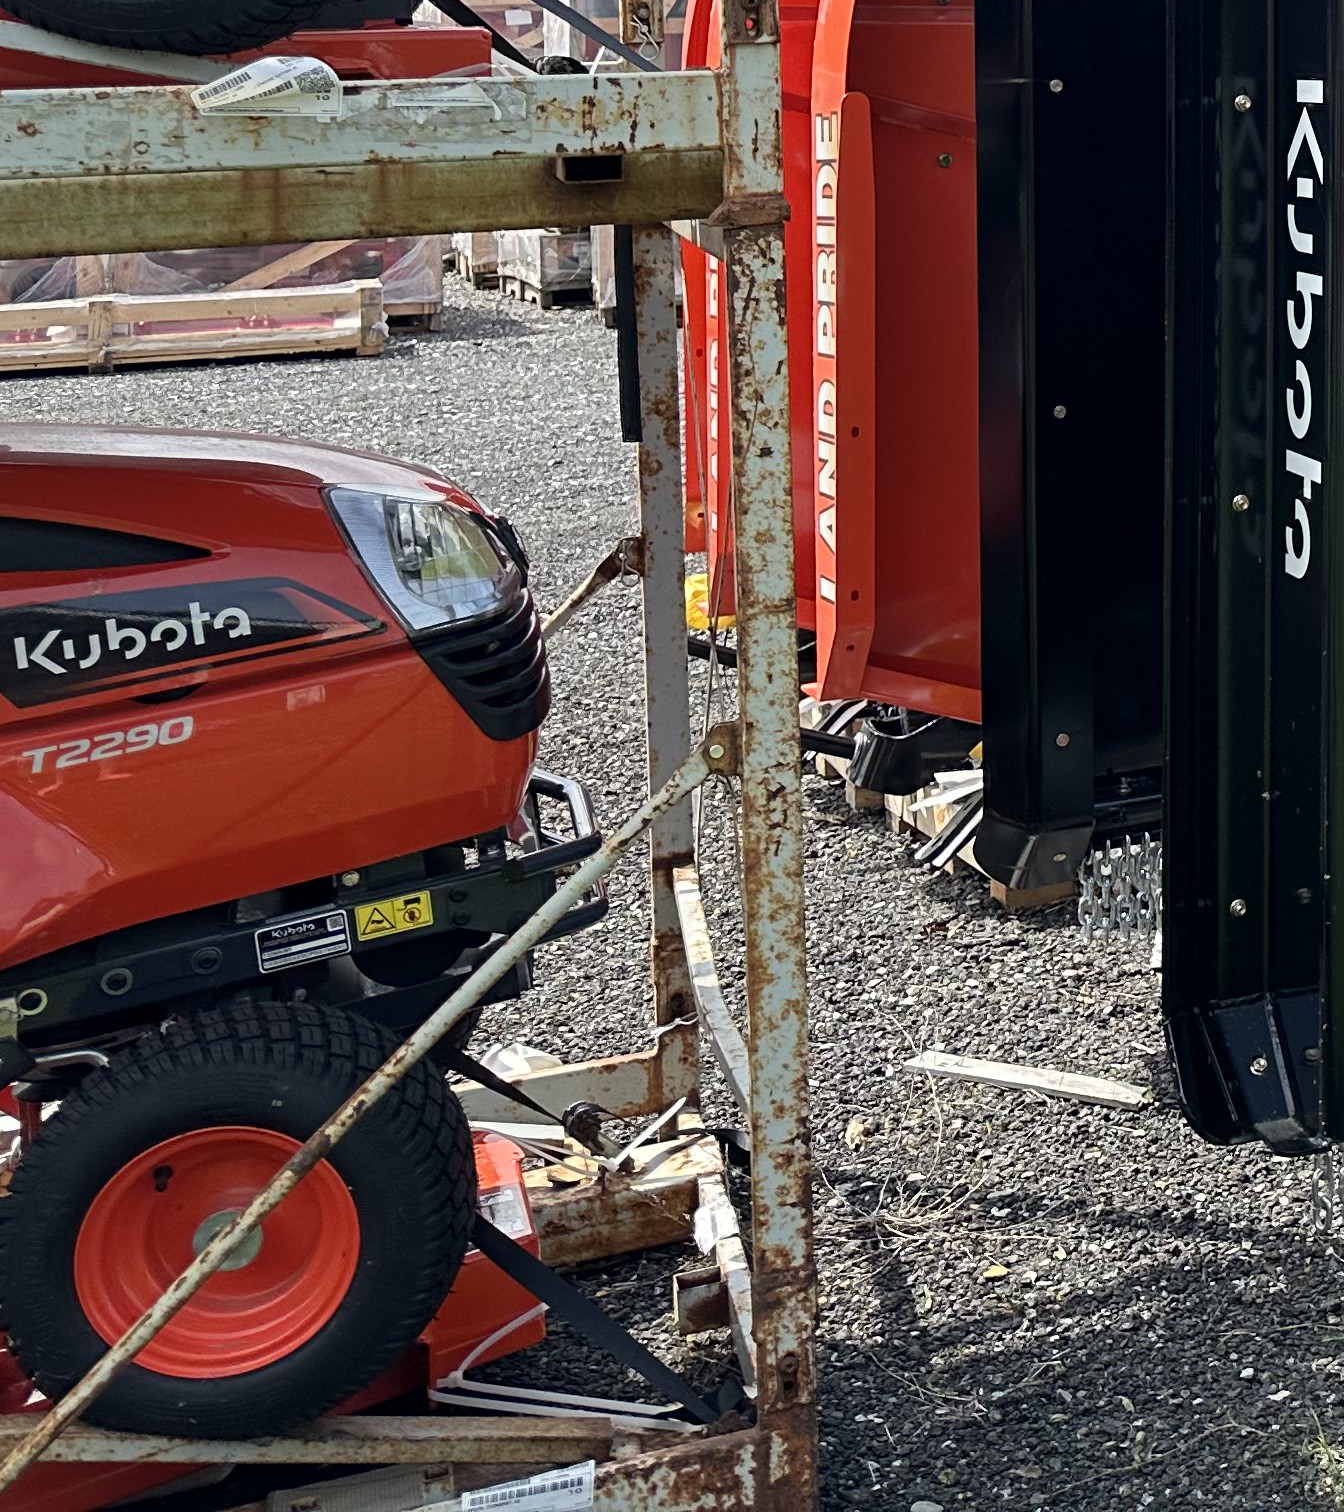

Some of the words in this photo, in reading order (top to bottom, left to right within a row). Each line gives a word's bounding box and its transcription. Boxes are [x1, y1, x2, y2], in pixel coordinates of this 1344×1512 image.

[1285, 79, 1324, 579] Kubota
[13, 601, 252, 675] Kubota
[22, 715, 195, 775] T2290
